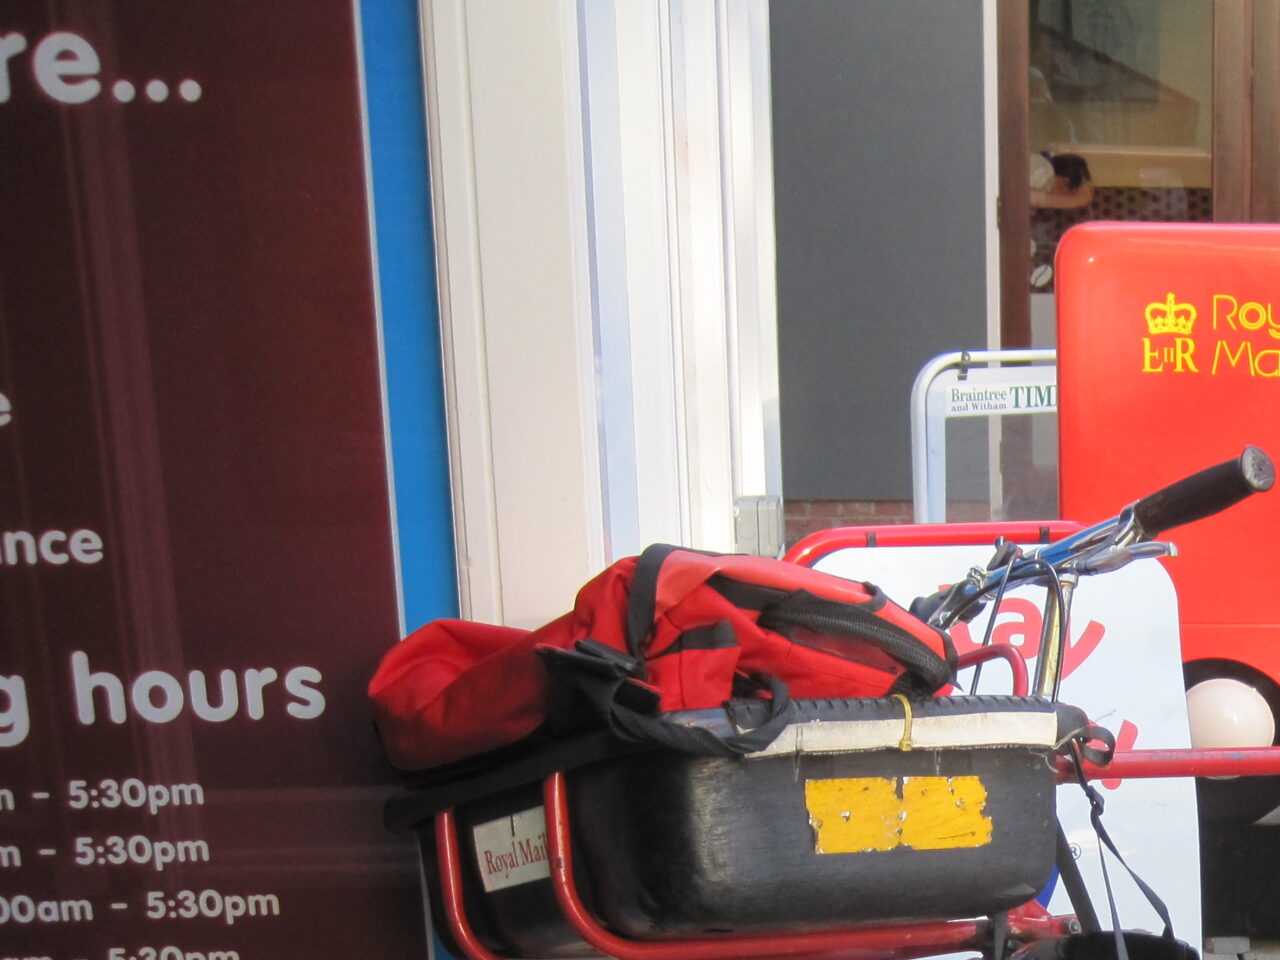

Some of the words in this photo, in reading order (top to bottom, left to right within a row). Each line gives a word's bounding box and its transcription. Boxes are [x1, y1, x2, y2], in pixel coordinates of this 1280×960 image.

[951, 387, 1007, 402] Braintree
[951, 404, 969, 412] and
[972, 401, 1007, 411] Witham
[1010, 384, 1057, 409] TIM
[0, 529, 104, 566] nce
[72, 651, 326, 725] hours
[69, 778, 204, 815] 5:30pm
[75, 835, 209, 871] 5:30pm
[484, 841, 520, 879] Royal
[147, 889, 280, 925] 5:30pm
